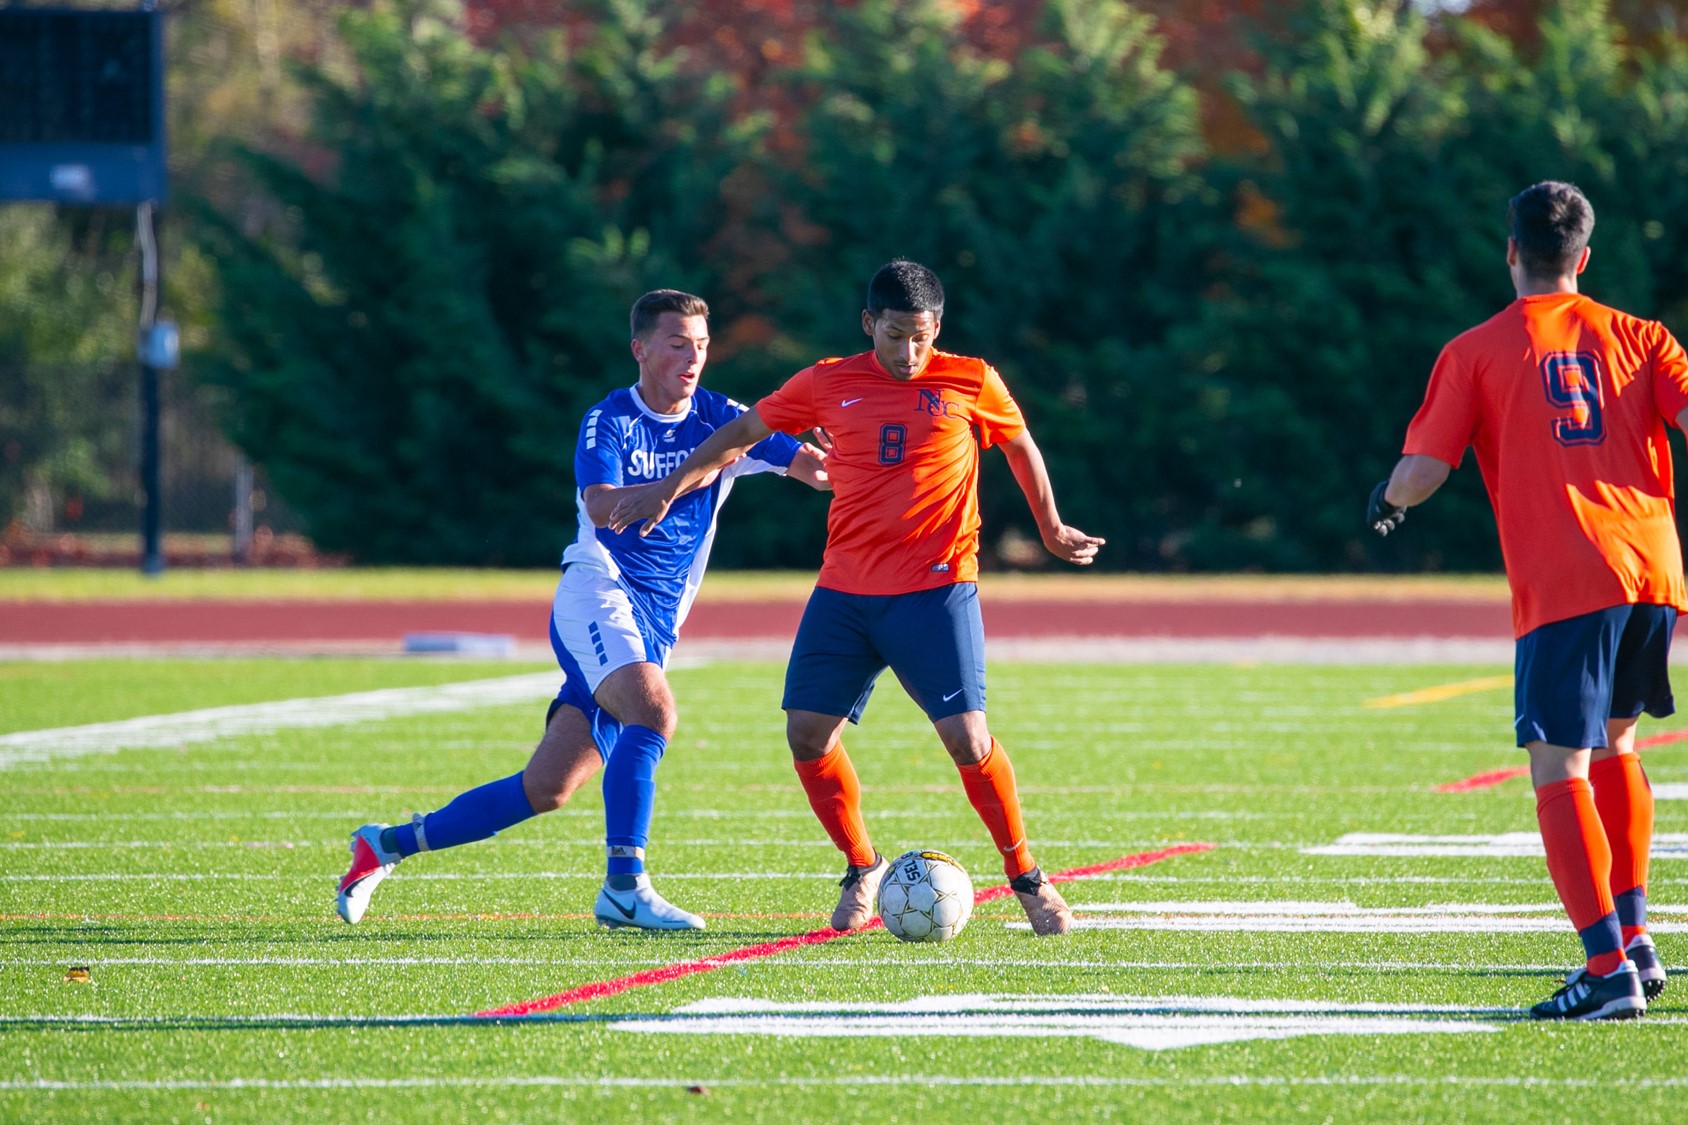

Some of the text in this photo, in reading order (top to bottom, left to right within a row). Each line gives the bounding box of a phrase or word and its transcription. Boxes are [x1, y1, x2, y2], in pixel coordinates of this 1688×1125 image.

[1539, 351, 1607, 447] 9
[627, 447, 696, 479] SUFFO
[878, 423, 908, 466] 8
